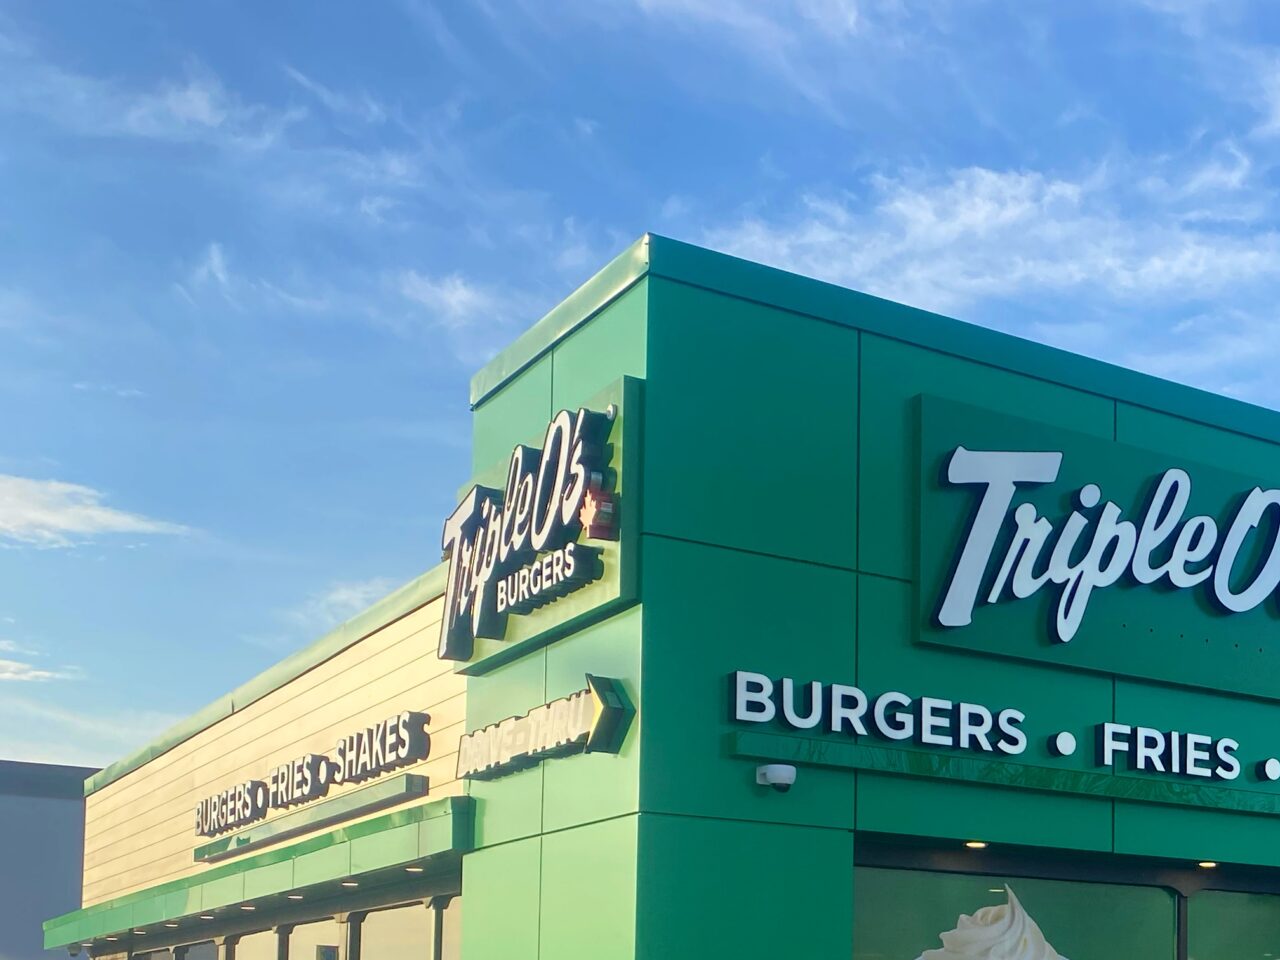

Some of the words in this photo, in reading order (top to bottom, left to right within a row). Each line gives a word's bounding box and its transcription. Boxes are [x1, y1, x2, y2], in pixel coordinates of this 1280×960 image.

[496, 542, 575, 613] BURGERS
[194, 780, 252, 836] BURGERS
[268, 753, 312, 808] FRIES
[333, 710, 411, 783] SHAKES
[735, 669, 1028, 756] BURGERS
[1103, 722, 1241, 781] FRIES
